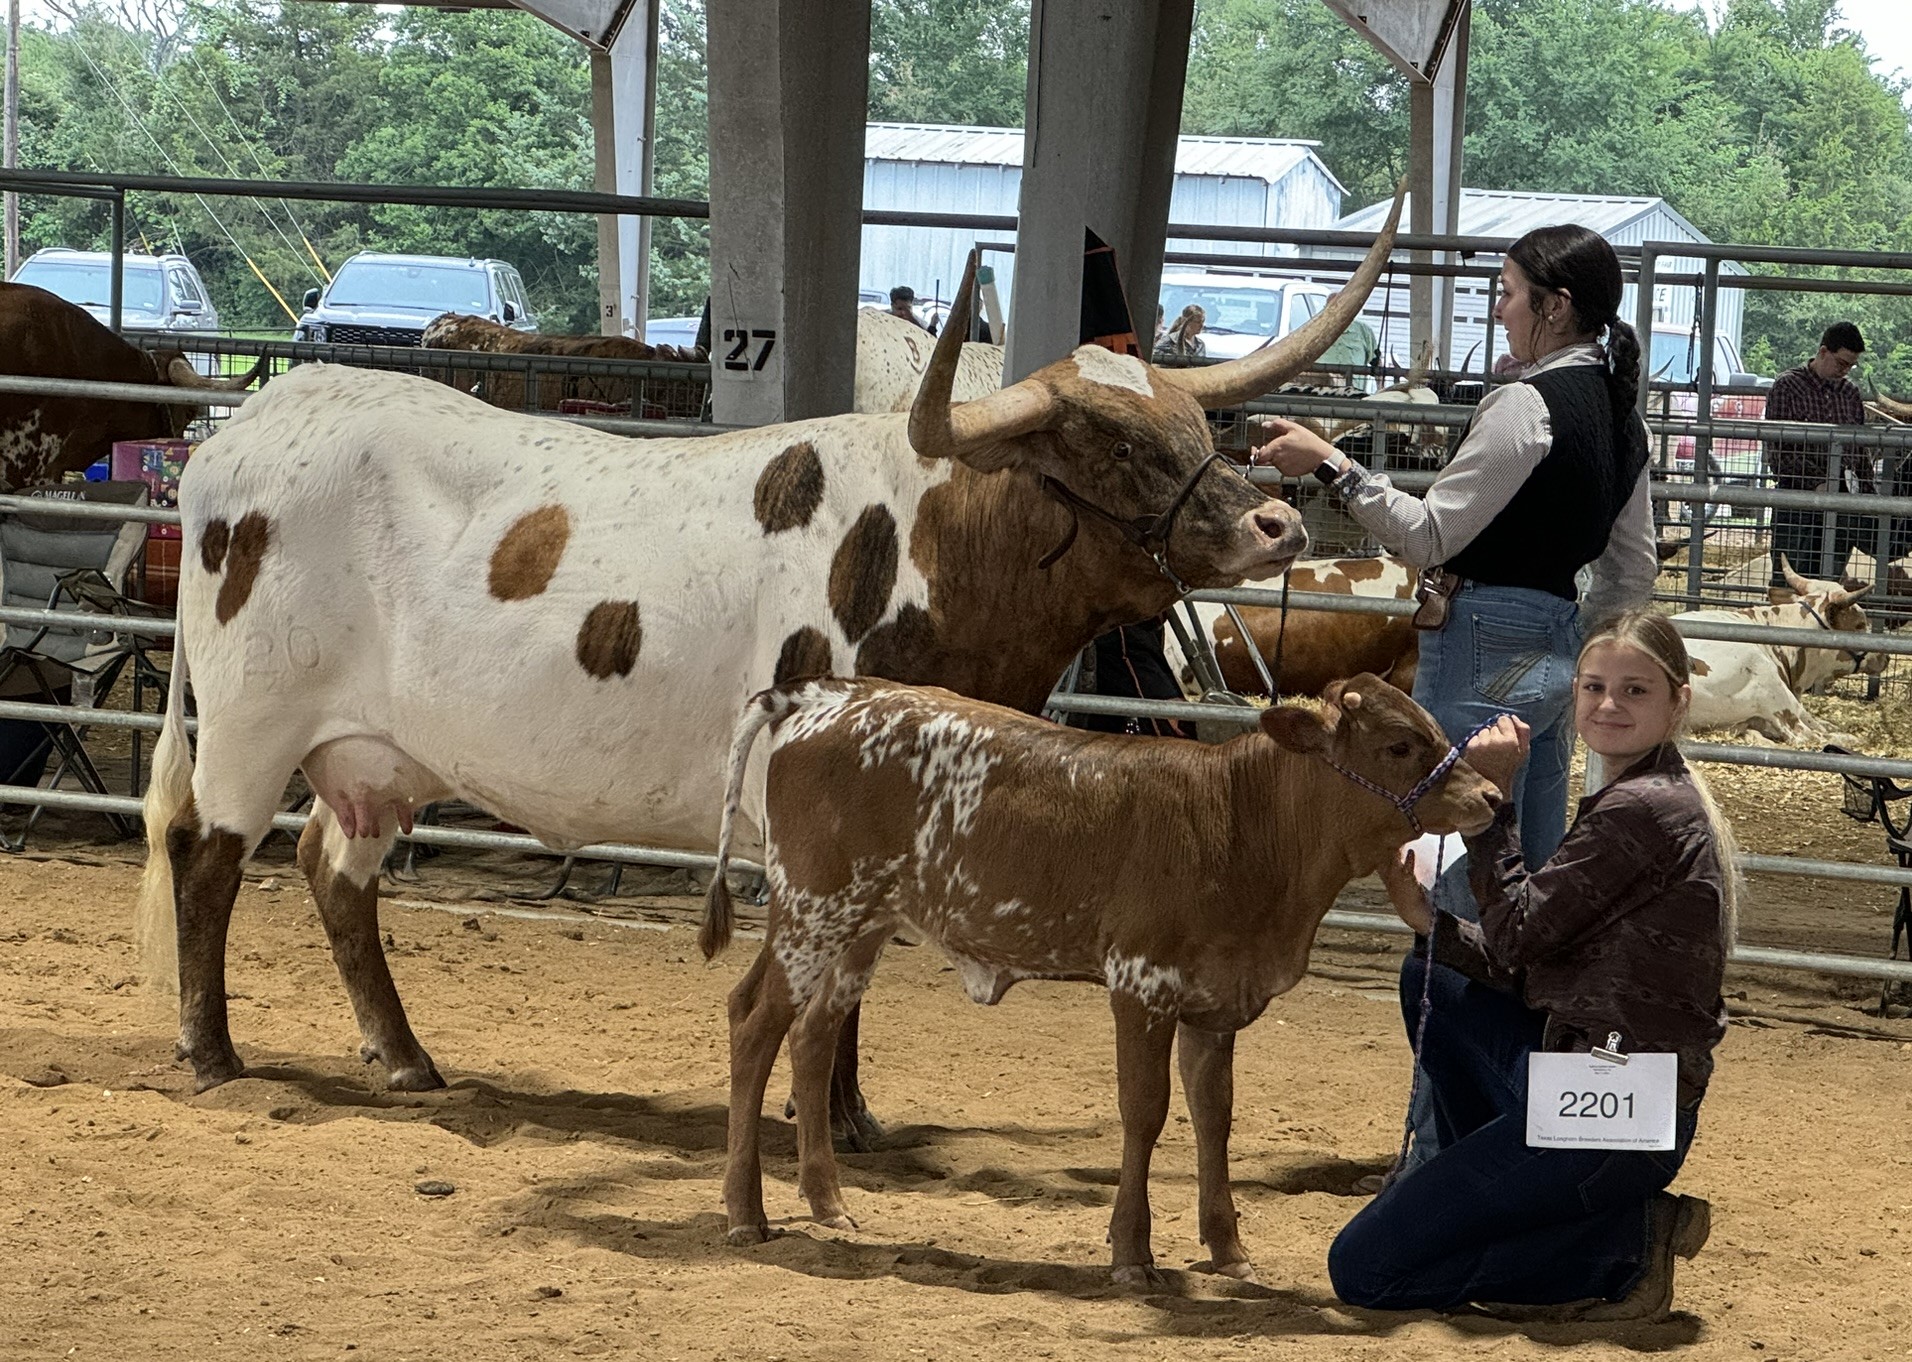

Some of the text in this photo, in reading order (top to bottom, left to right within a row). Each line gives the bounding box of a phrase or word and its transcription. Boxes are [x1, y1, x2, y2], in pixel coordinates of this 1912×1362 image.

[723, 329, 776, 372] 27
[44, 489, 87, 501] MAGELLN
[1558, 1091, 1634, 1119] 2201
